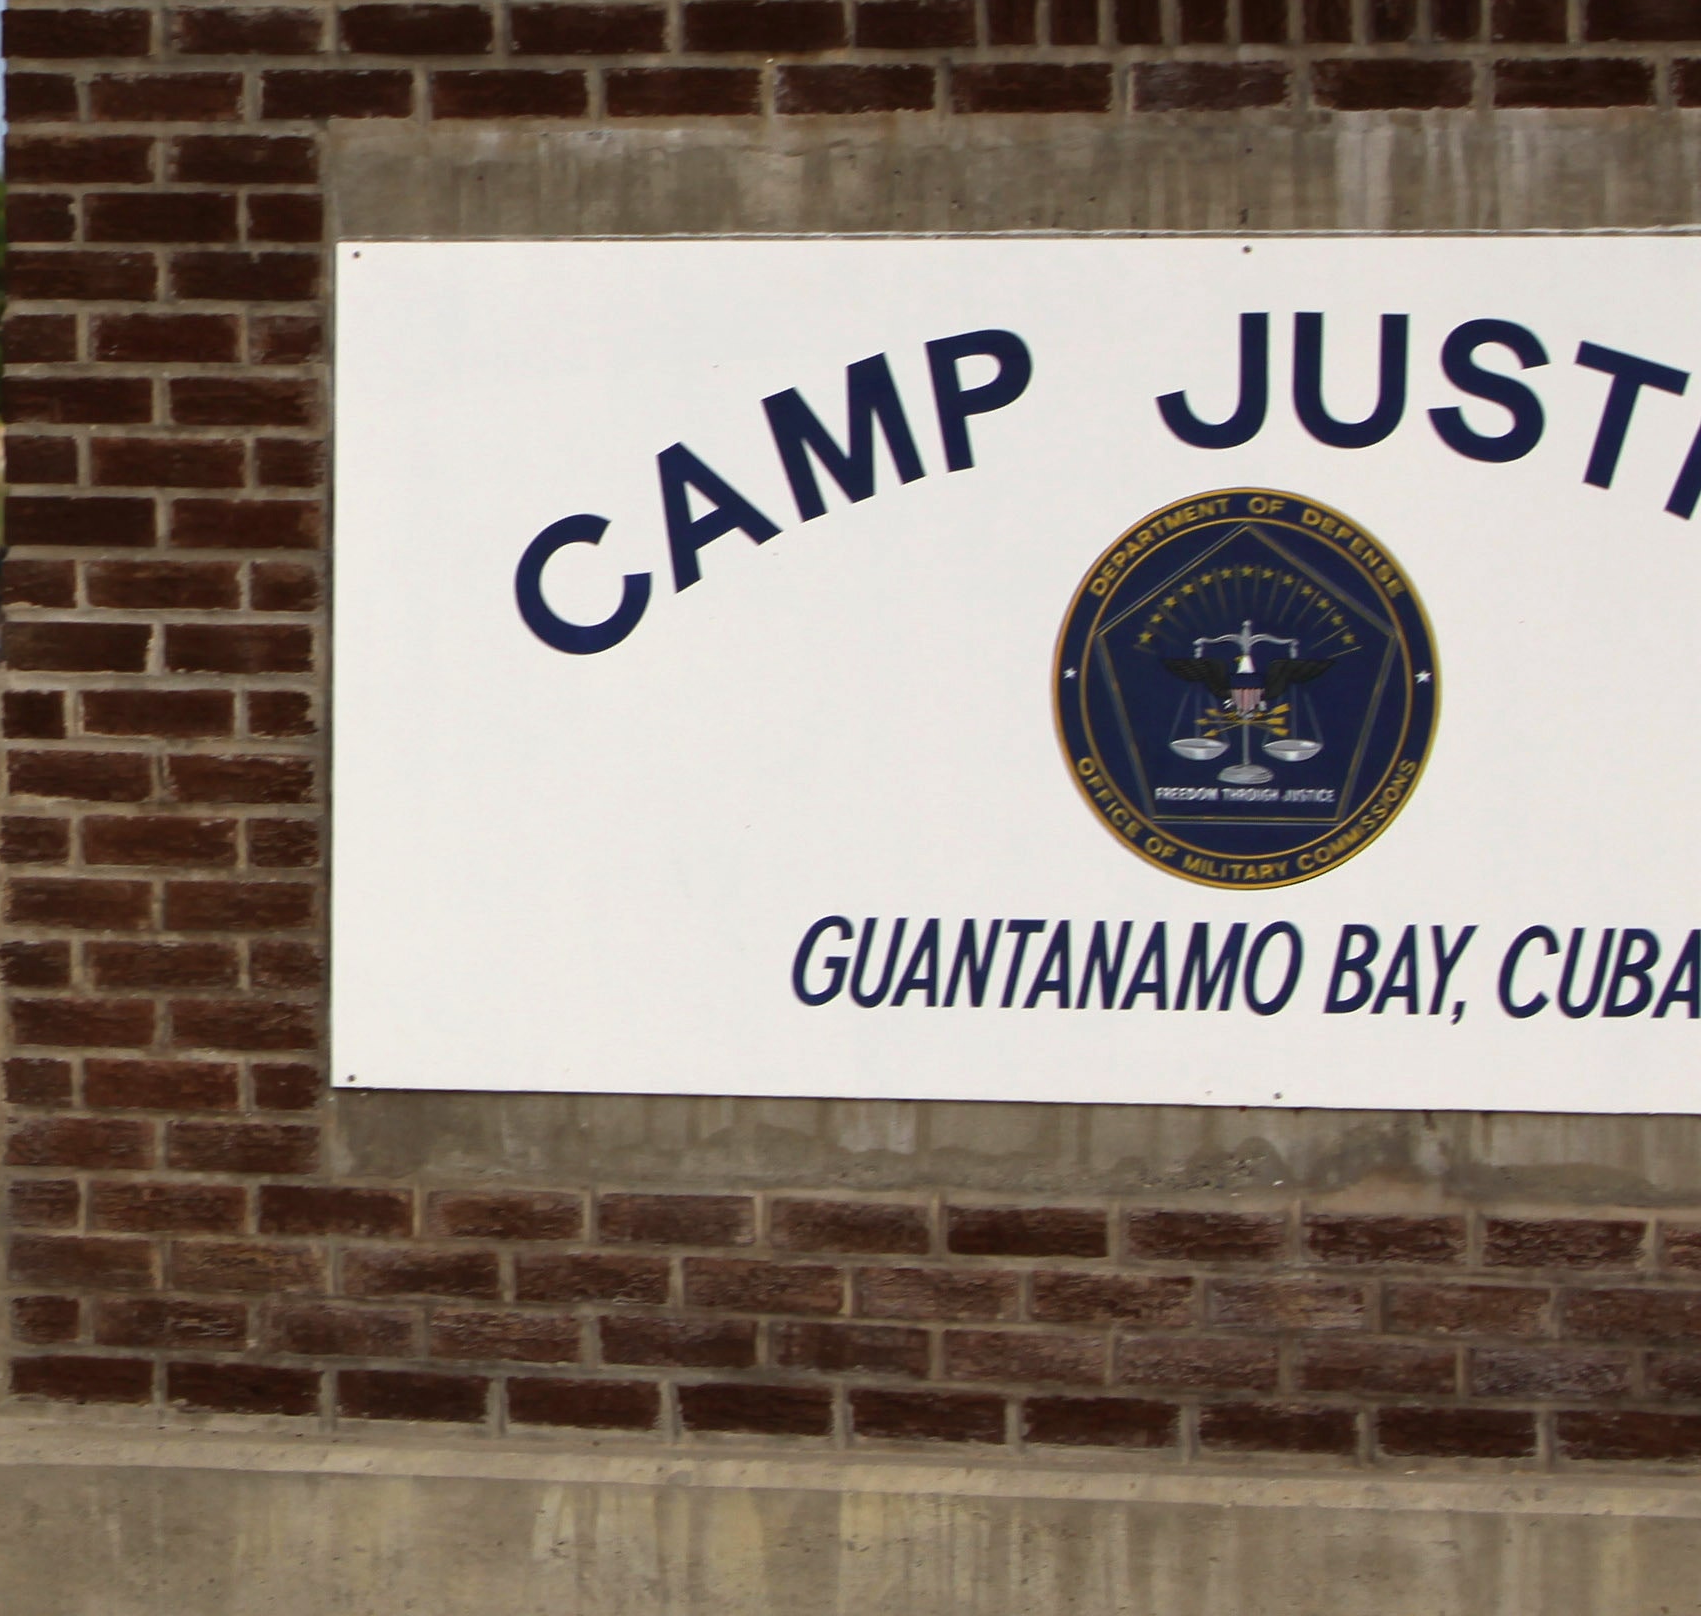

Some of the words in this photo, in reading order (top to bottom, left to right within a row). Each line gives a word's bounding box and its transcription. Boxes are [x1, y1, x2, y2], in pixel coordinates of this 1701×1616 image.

[516, 330, 1031, 655] CAMP
[1090, 497, 1230, 598] DEPARTMENT
[1248, 496, 1286, 515] OF
[1301, 506, 1407, 598] DEFENSE
[1077, 757, 1139, 839] OFFICE
[1145, 836, 1178, 859] OF
[1182, 855, 1288, 880] MILITARY
[1297, 758, 1417, 870] COMMISSIONS
[1155, 787, 1218, 801] FREEDOM
[1221, 787, 1280, 802] THROUGH
[1282, 787, 1335, 803] JUSTICE
[793, 916, 1302, 1015] GUANTANAMO
[1324, 924, 1477, 1024] BAY,
[1499, 925, 1701, 1018] CUBA
